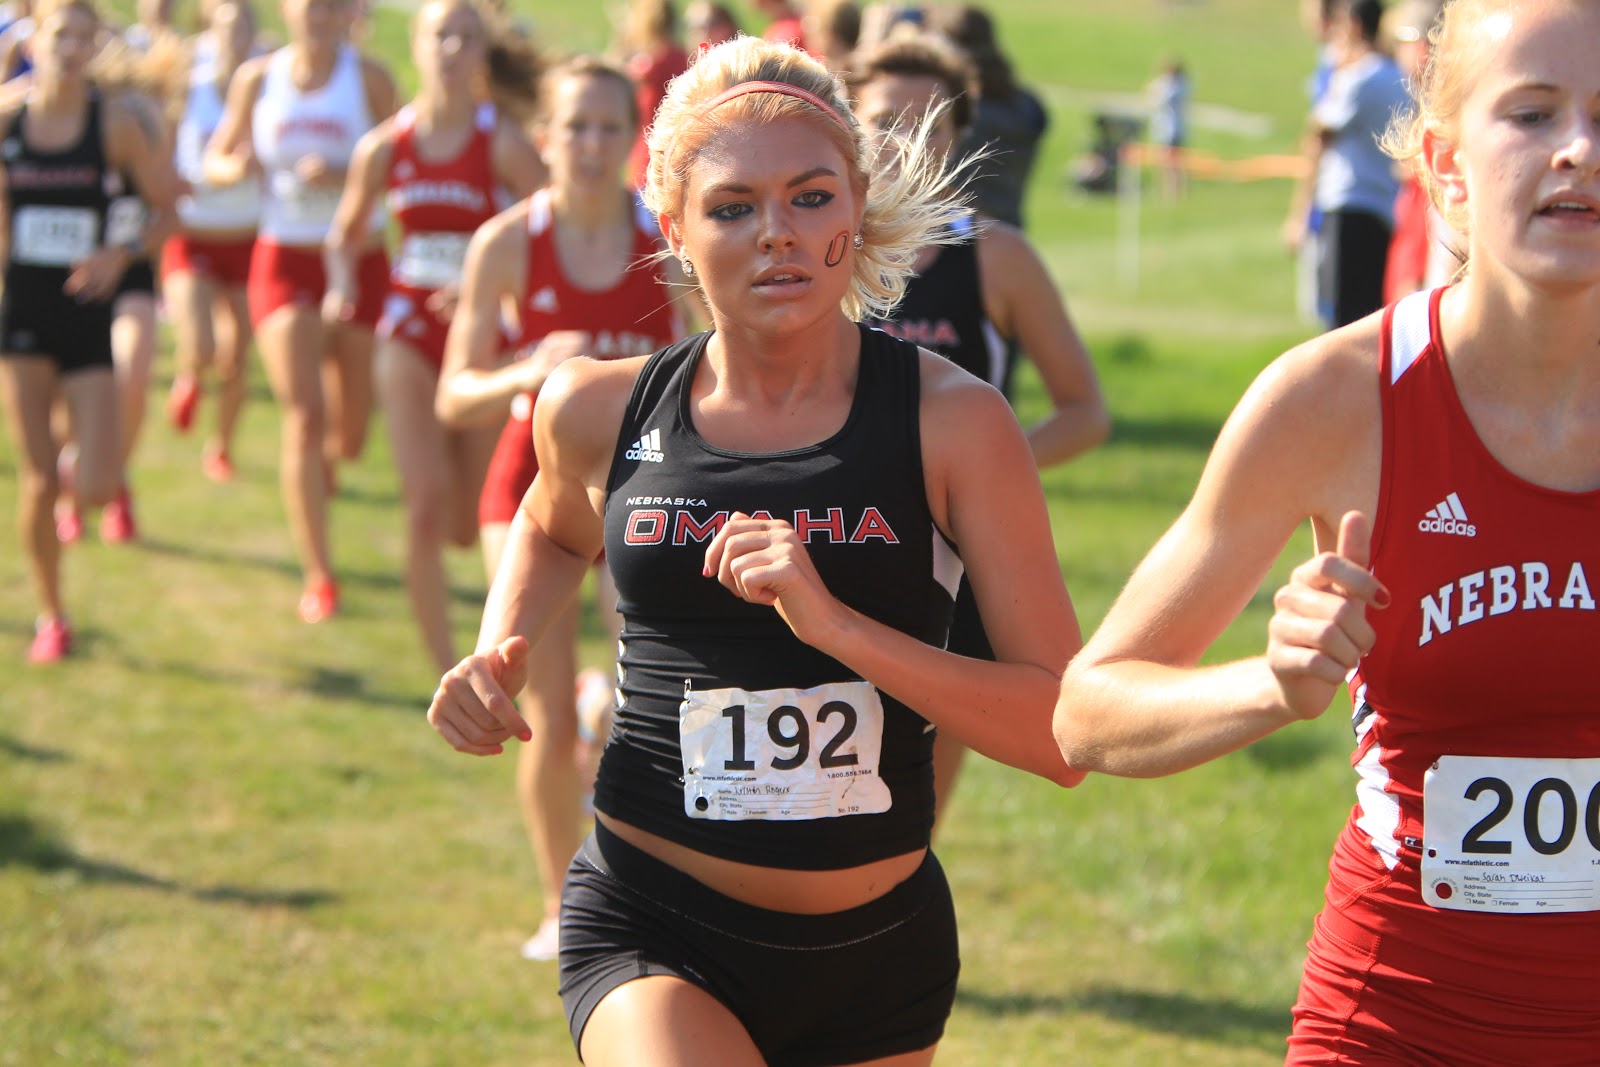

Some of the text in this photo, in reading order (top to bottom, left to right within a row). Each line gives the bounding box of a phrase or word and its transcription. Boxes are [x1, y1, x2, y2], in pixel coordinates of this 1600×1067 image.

[625, 448, 665, 463] adidas
[626, 496, 708, 507] NEBRASKA
[624, 507, 900, 546] OMHA
[1418, 517, 1477, 537] adidas
[1419, 561, 1596, 647] NEBRA
[722, 700, 859, 771] 192
[1462, 777, 1600, 856] 20
[1444, 859, 1510, 867] www.mfathletic.com
